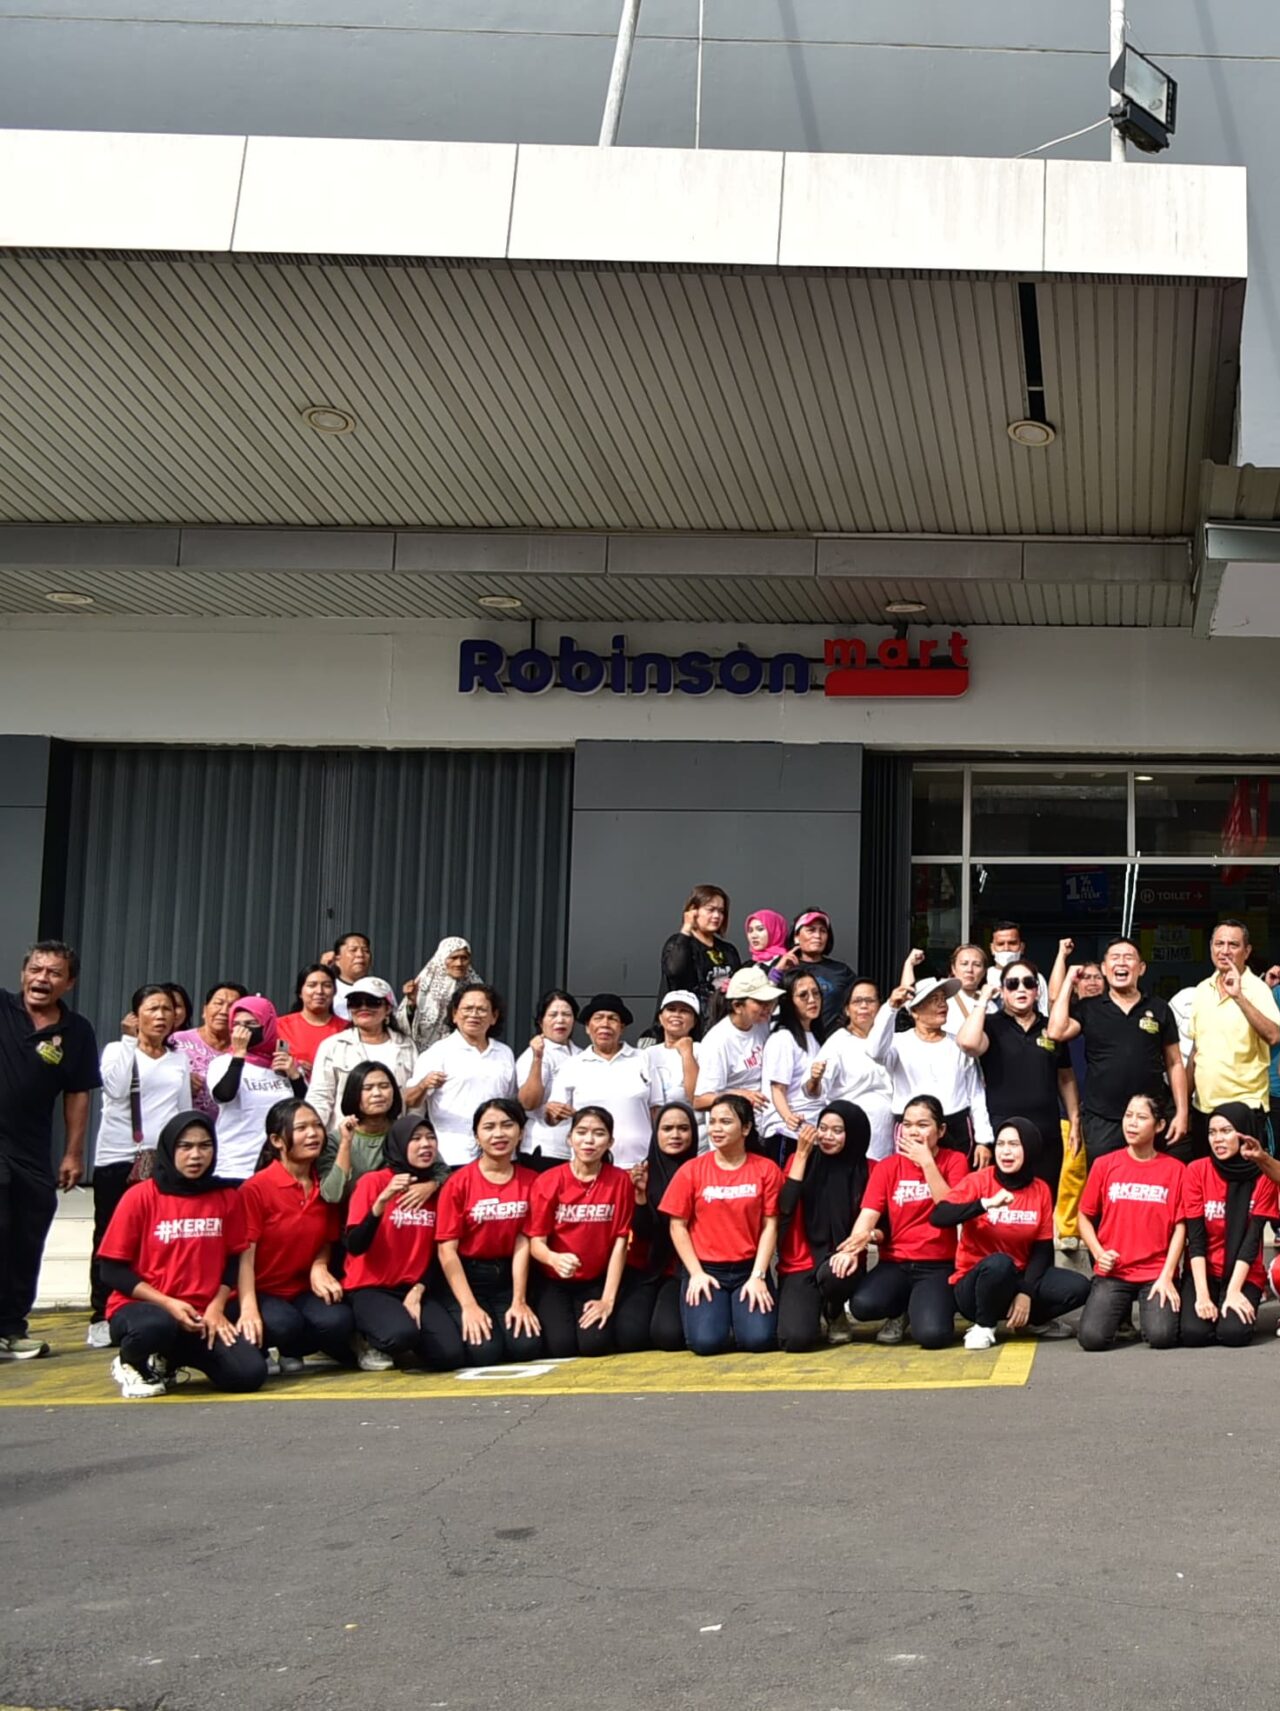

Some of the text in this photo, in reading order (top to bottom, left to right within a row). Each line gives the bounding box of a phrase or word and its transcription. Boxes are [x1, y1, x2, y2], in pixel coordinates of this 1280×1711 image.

[457, 631, 969, 695] Robinson mart
[554, 1203, 615, 1224] #KEREN
[154, 1217, 222, 1244] #KEREN
